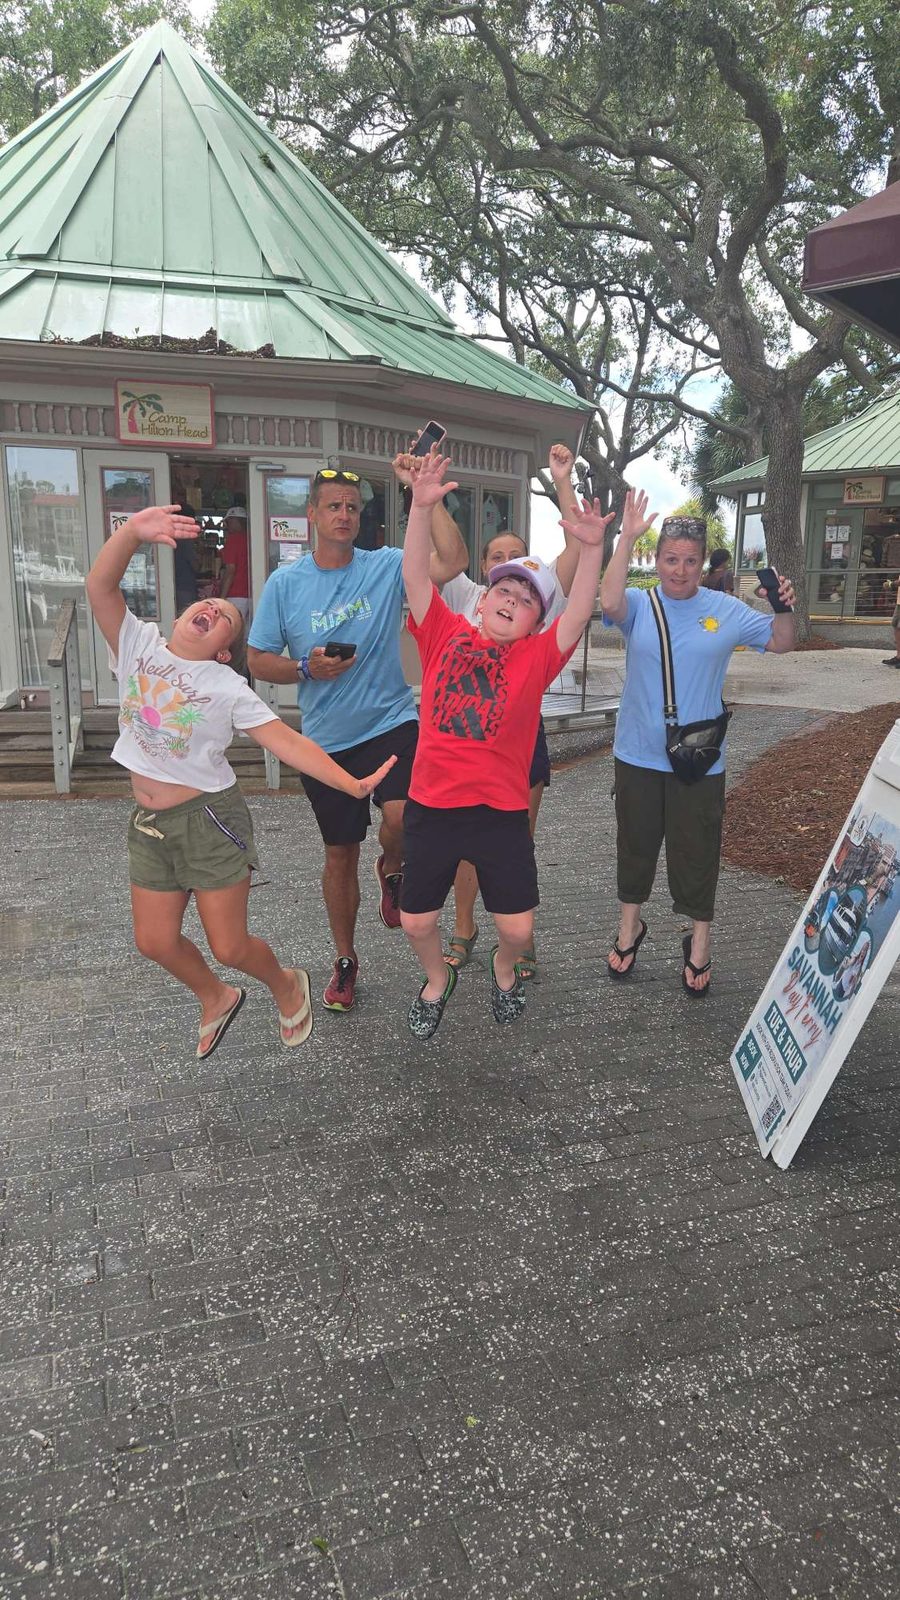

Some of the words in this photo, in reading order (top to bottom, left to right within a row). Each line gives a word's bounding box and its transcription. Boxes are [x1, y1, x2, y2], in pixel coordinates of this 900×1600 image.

[141, 422, 173, 436] Hilton
[177, 425, 208, 439] Head
[148, 411, 187, 428] Camp
[311, 594, 371, 633] MIAMI
[134, 655, 176, 680] Neill
[171, 672, 212, 707] Surf
[783, 970, 802, 1015] Day
[794, 992, 822, 1049] Ferry
[787, 946, 843, 1035] SAVANNAH
[740, 1052, 750, 1071] NOW
[747, 1038, 759, 1060] BOOK
[767, 1006, 782, 1035] TUE
[777, 1027, 787, 1046] &
[782, 1034, 803, 1078] THUR
